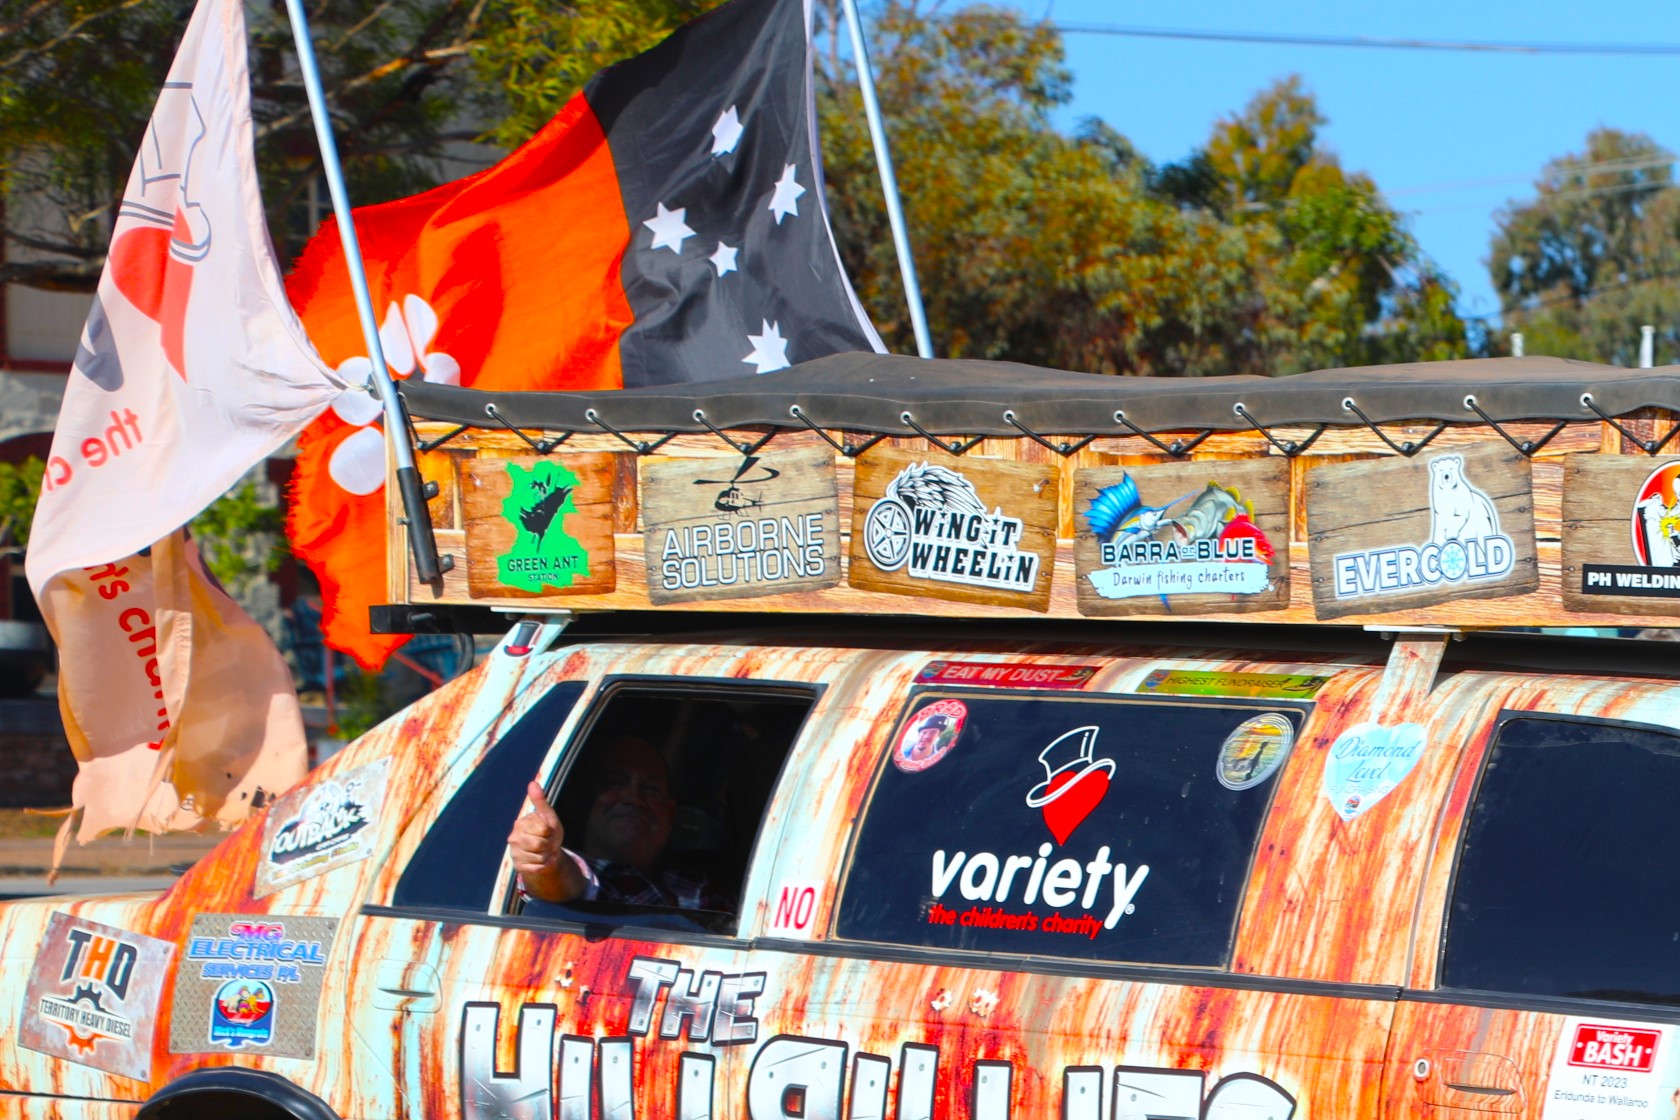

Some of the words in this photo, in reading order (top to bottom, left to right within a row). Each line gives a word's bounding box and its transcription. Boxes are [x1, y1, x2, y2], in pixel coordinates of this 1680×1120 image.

[661, 513, 825, 561] AIRBORNE
[507, 557, 548, 572] GREEN
[553, 555, 579, 570] ANT
[1102, 542, 1179, 563] BARRA
[1197, 538, 1255, 560] BLUE
[527, 573, 559, 583] STATION
[661, 543, 826, 592] SOLUTIONS
[1113, 571, 1152, 587] Darwin
[1157, 570, 1192, 590] fishing
[1198, 566, 1245, 584] charters
[1334, 537, 1515, 598] EVERCOLD
[1587, 571, 1611, 588] PH
[942, 665, 980, 680] EAT
[980, 666, 1011, 681] MY
[1011, 667, 1064, 683] DUST
[1166, 676, 1216, 687] HIGHEST
[1214, 676, 1286, 689] FUNDRAISER
[273, 806, 362, 854] OUTBACK
[932, 842, 1150, 930] variety
[774, 886, 815, 929] NO
[928, 904, 957, 926] the
[959, 906, 1039, 931] children's
[1042, 912, 1104, 940] charity
[188, 938, 325, 964] ELECTRICAL
[60, 928, 139, 1001] THD
[202, 962, 275, 980] SERVICES
[627, 956, 768, 1046] THE
[40, 998, 80, 1026] TERRITORY
[80, 1009, 107, 1030] HEAVY
[106, 1017, 132, 1039] DIESEL
[1596, 1030, 1634, 1048] Variety
[1583, 1040, 1642, 1067] BASH
[1582, 1074, 1598, 1087] NT
[1600, 1075, 1628, 1089] 2023
[1597, 1092, 1607, 1105] to
[1608, 1094, 1649, 1108] Wallaroo
